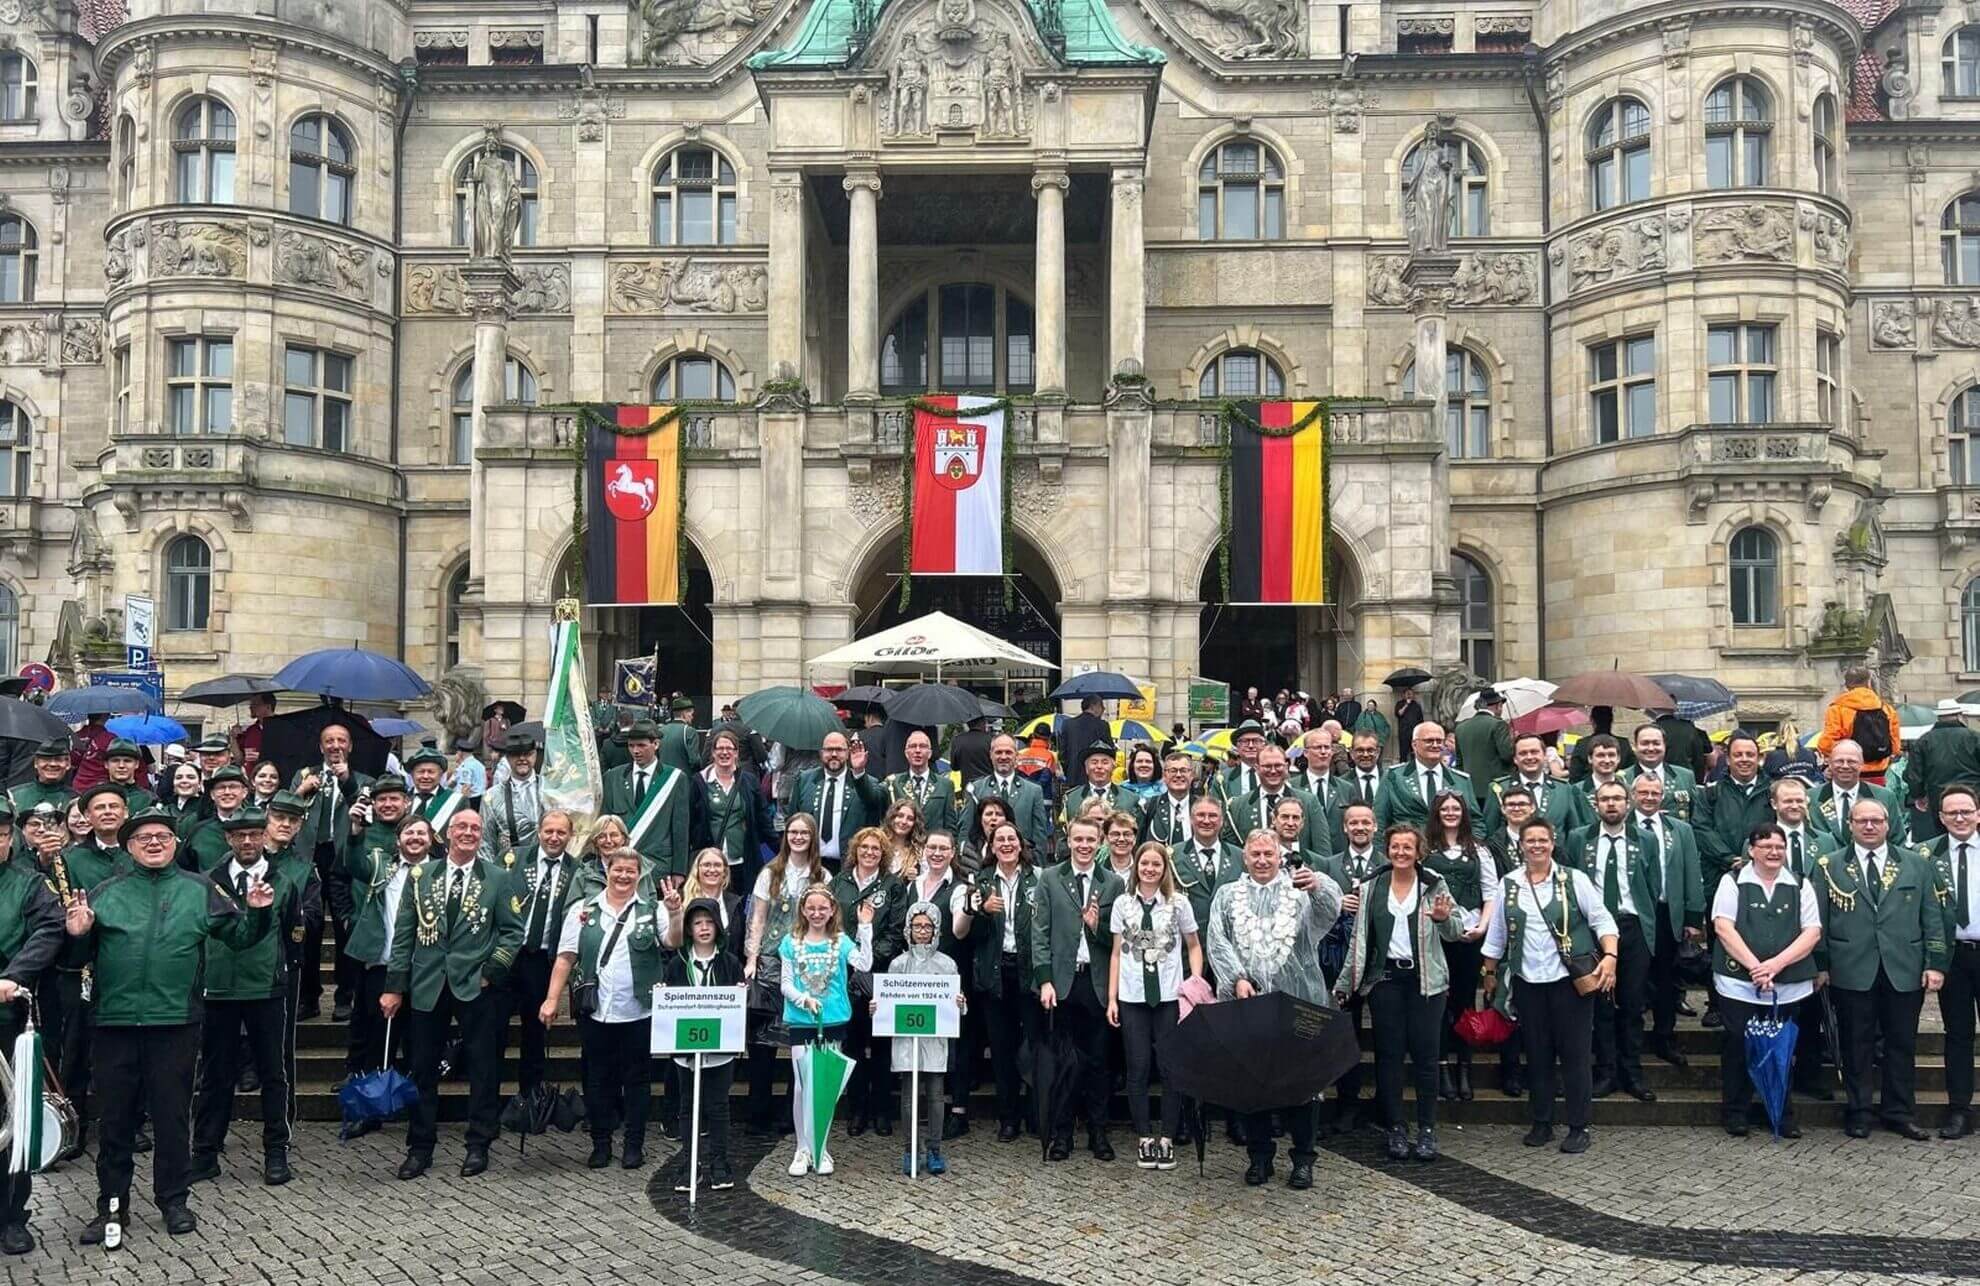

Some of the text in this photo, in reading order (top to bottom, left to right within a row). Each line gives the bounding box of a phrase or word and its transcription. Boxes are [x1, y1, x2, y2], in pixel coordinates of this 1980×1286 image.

[132, 649, 144, 667] P
[883, 979, 949, 988] Schützenverein
[664, 992, 736, 1001] Spielmannszug
[938, 992, 952, 1000] e.V.
[906, 1012, 925, 1027] 50
[688, 1027, 709, 1042] 50
